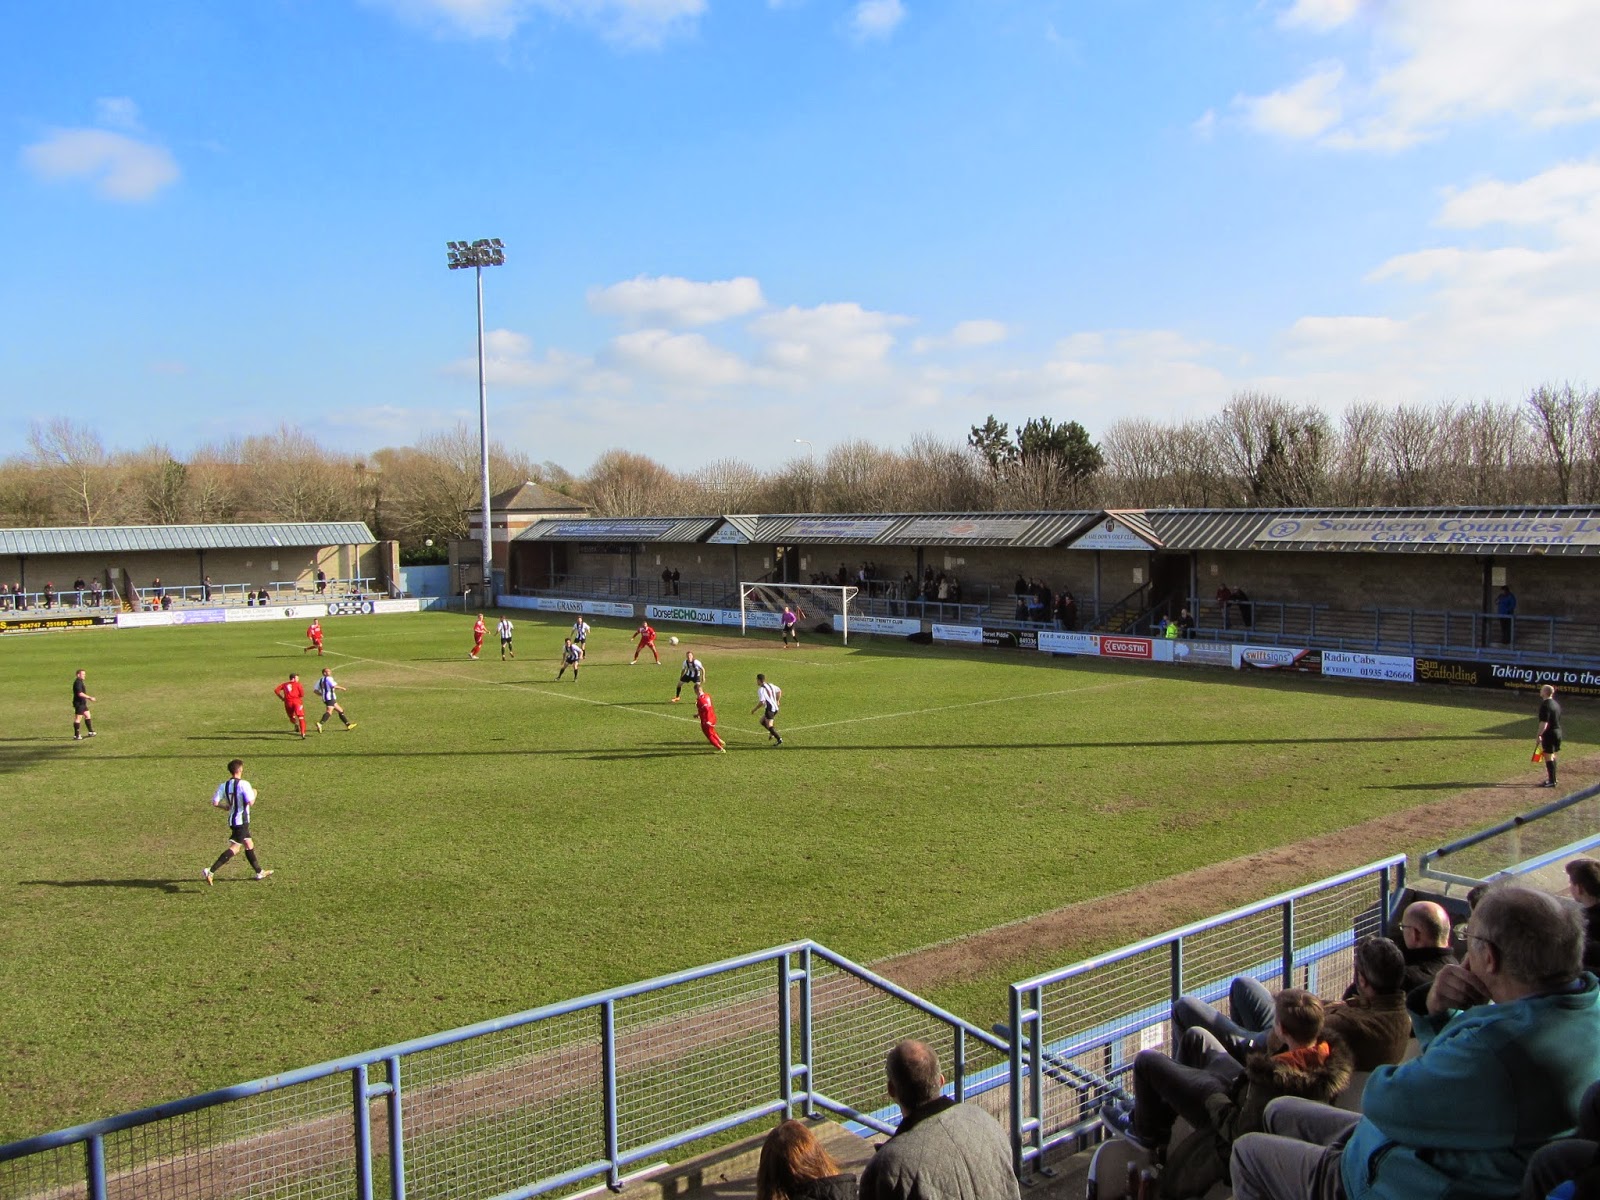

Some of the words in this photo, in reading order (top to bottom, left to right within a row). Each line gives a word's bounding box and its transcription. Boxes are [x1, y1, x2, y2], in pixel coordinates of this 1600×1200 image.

[1312, 519, 1427, 532] Southern
[1437, 519, 1564, 533] Counties
[1371, 531, 1417, 542] Cafe
[1422, 532, 1443, 542] &
[1446, 532, 1576, 544] Restaurant
[652, 607, 715, 623] DorsetECHO.co.uk
[1246, 651, 1288, 662] swiftsigns
[1323, 652, 1350, 663] Radio
[1352, 655, 1376, 665] Cabs
[1415, 658, 1438, 670] Sam
[1360, 668, 1382, 677] 01935
[1384, 670, 1412, 680] 426666
[1420, 666, 1478, 684] Scaffolding
[1490, 664, 1533, 682] Taking
[1535, 670, 1560, 683] you
[1563, 671, 1578, 683] to
